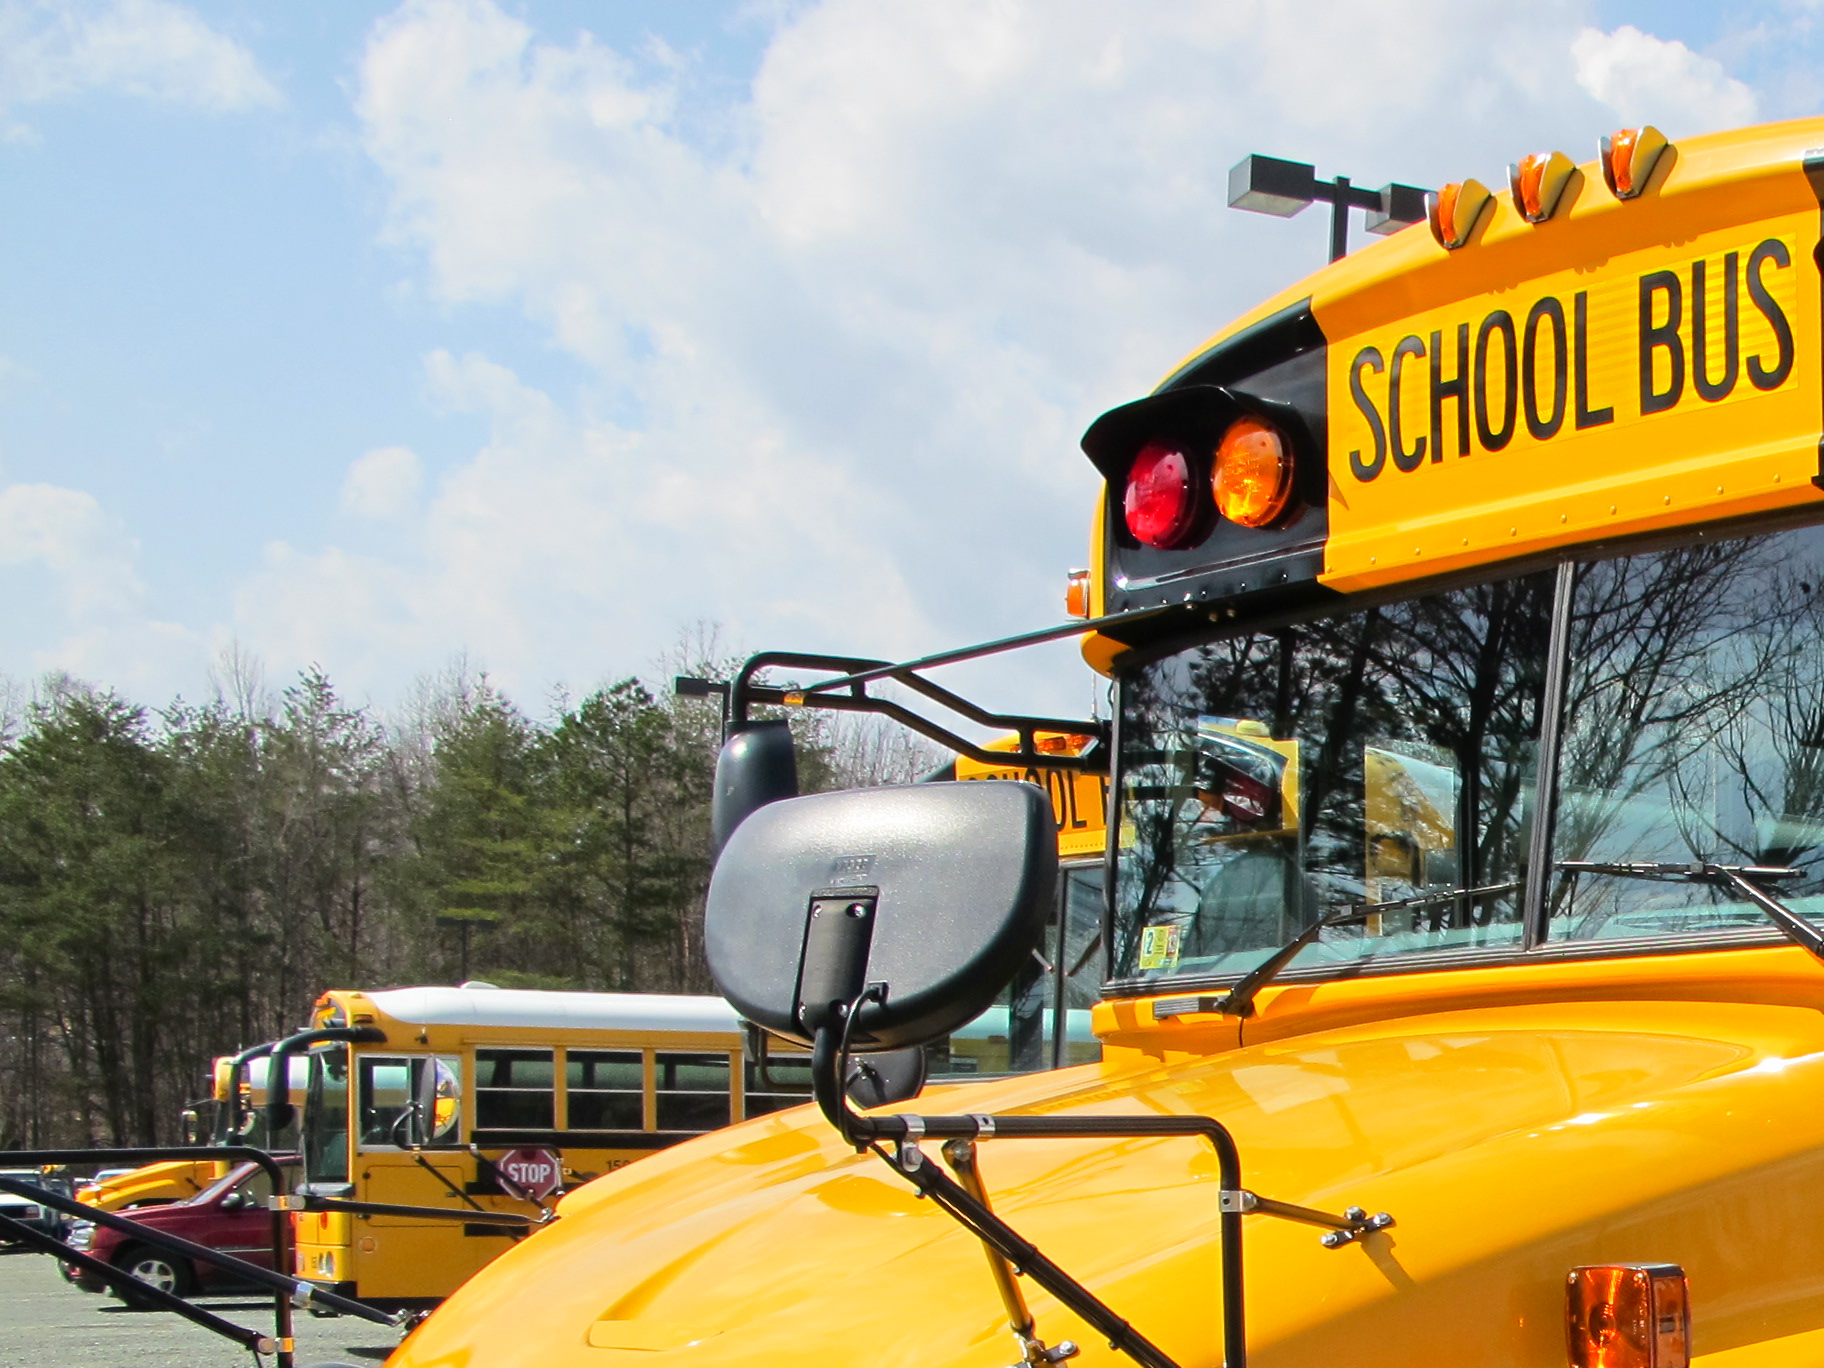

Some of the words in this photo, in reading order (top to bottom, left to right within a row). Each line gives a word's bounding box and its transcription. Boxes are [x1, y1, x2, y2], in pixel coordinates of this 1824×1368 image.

[1348, 290, 1614, 483] SCHOOL
[1638, 238, 1795, 417] BUS
[507, 1163, 551, 1184] STOP
